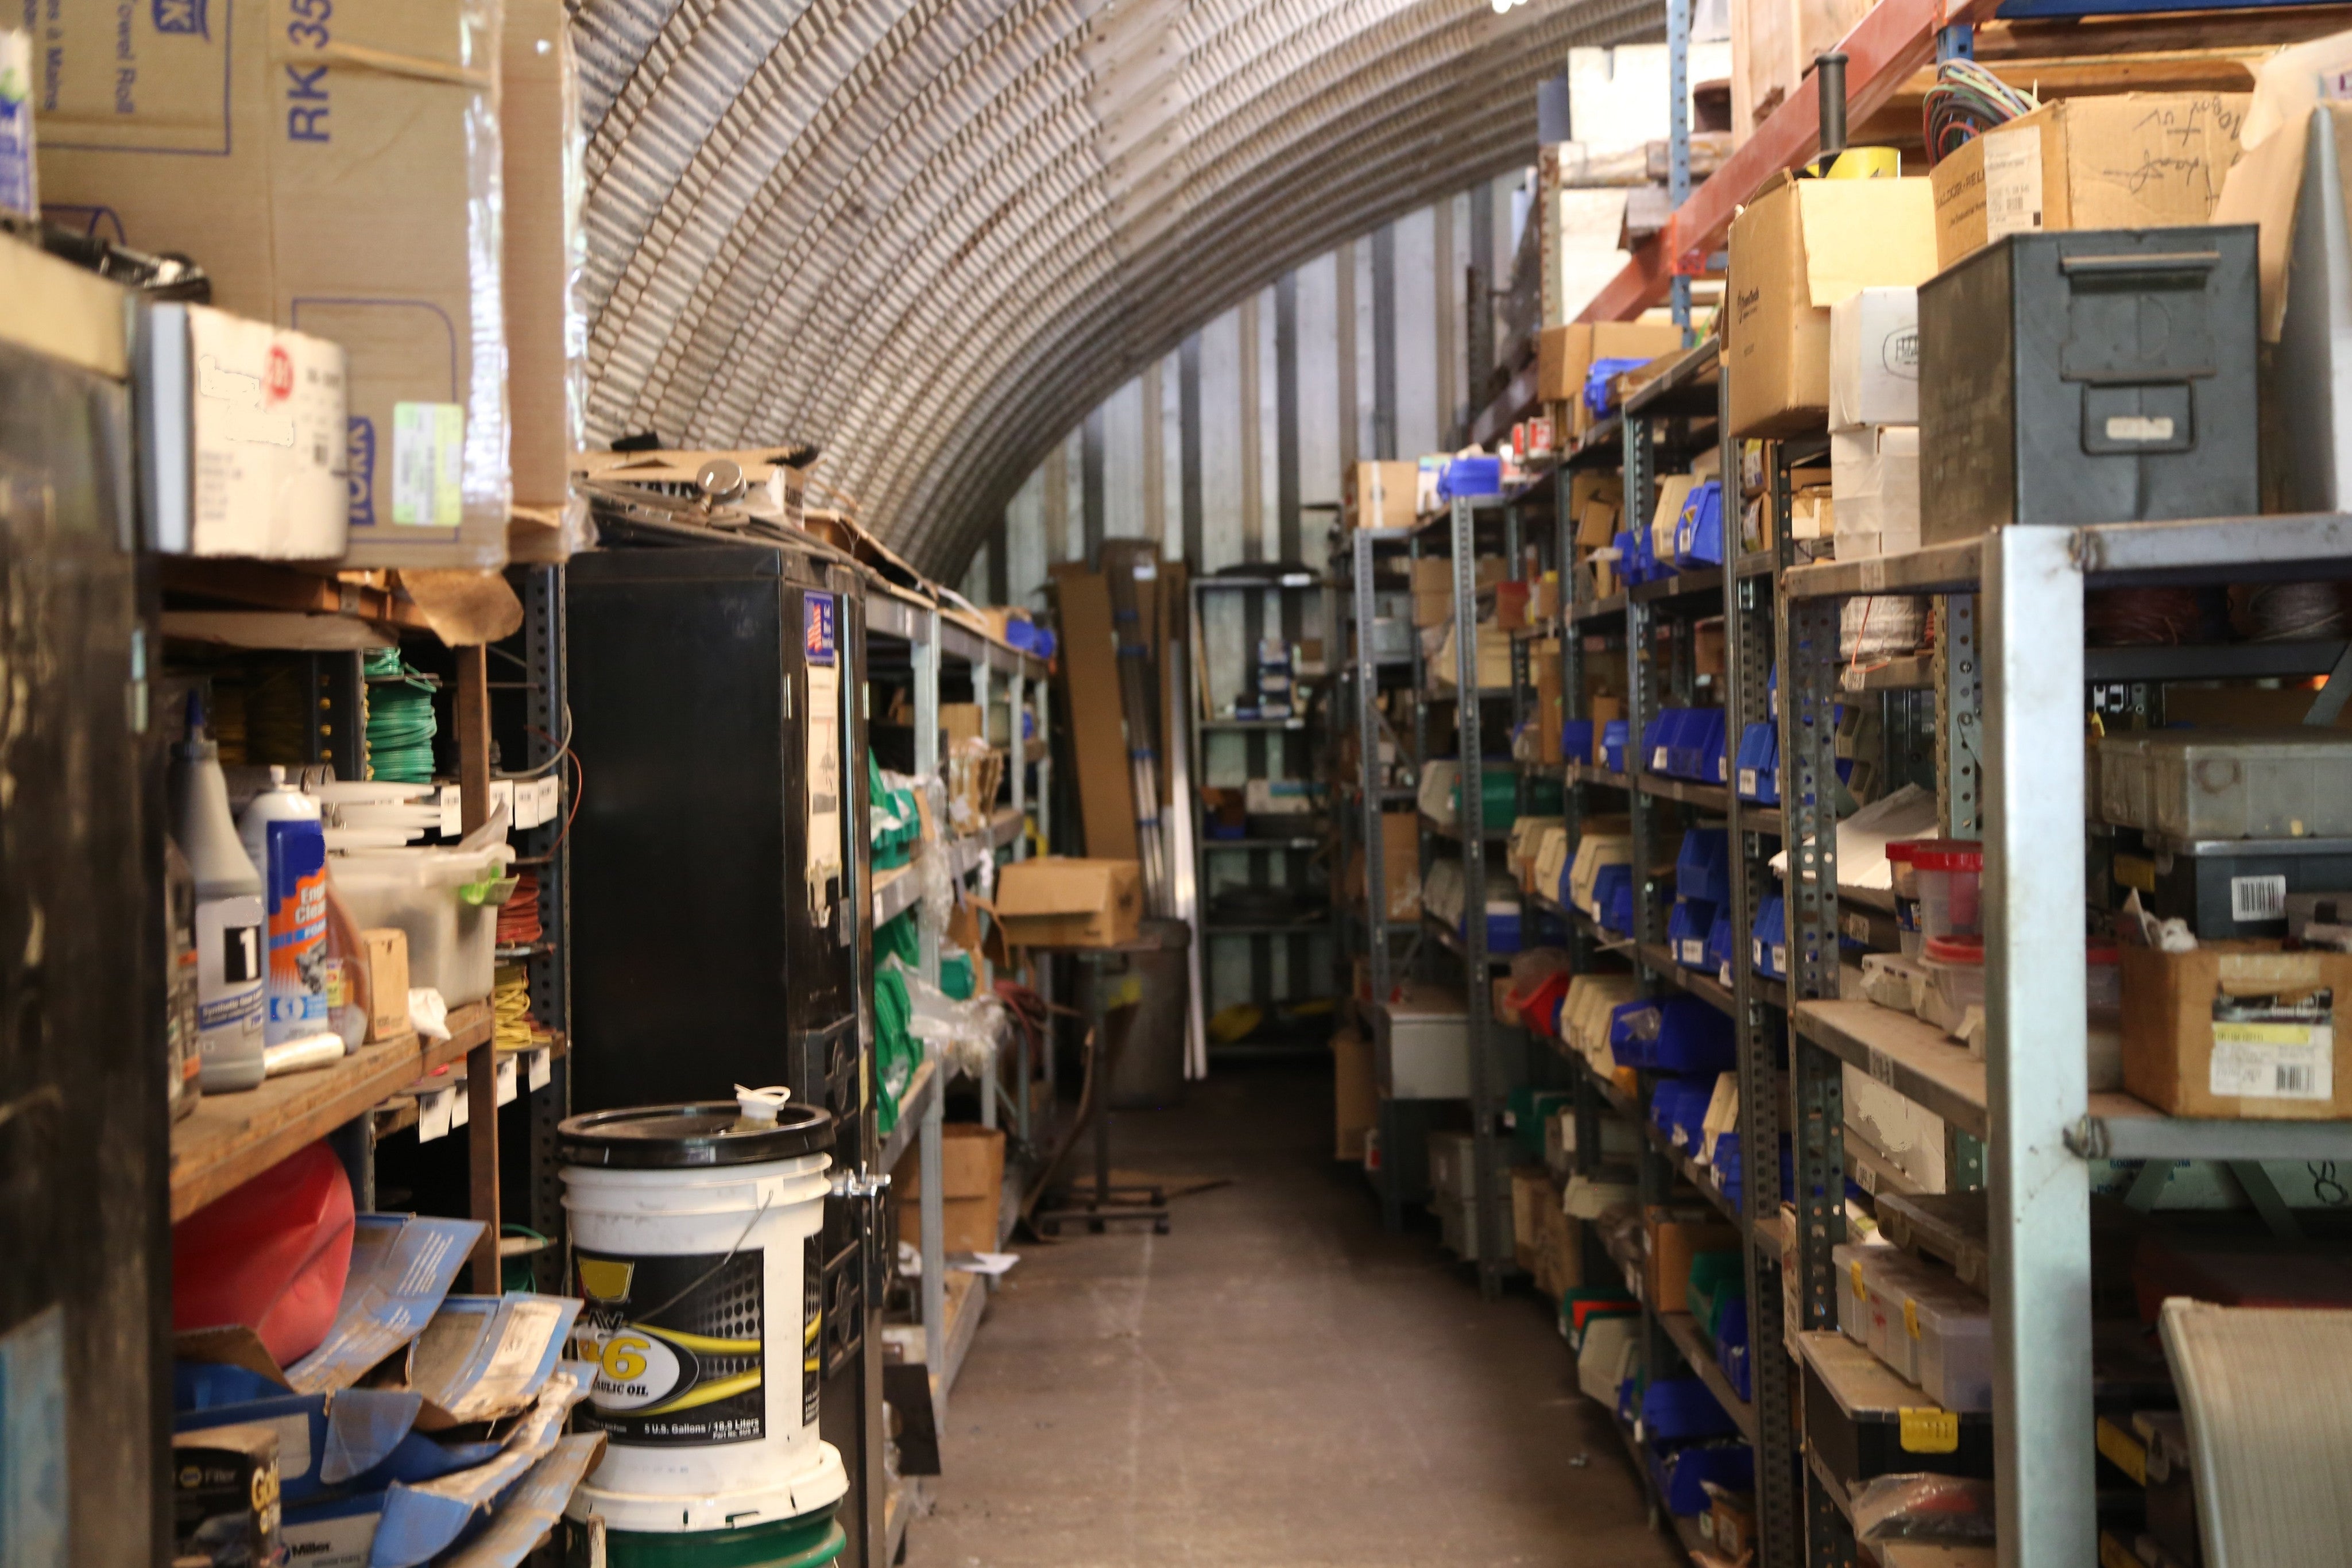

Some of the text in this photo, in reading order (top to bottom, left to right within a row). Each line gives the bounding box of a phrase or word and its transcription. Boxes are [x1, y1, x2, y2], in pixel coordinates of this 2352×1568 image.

[45, 47, 63, 111] Mains
[115, 68, 136, 113] Roll
[287, 63, 331, 143] RK
[239, 927, 257, 980] 1
[627, 1383, 648, 1396] OIL
[672, 1423, 706, 1435] Gallons
[735, 1418, 759, 1430] Liters
